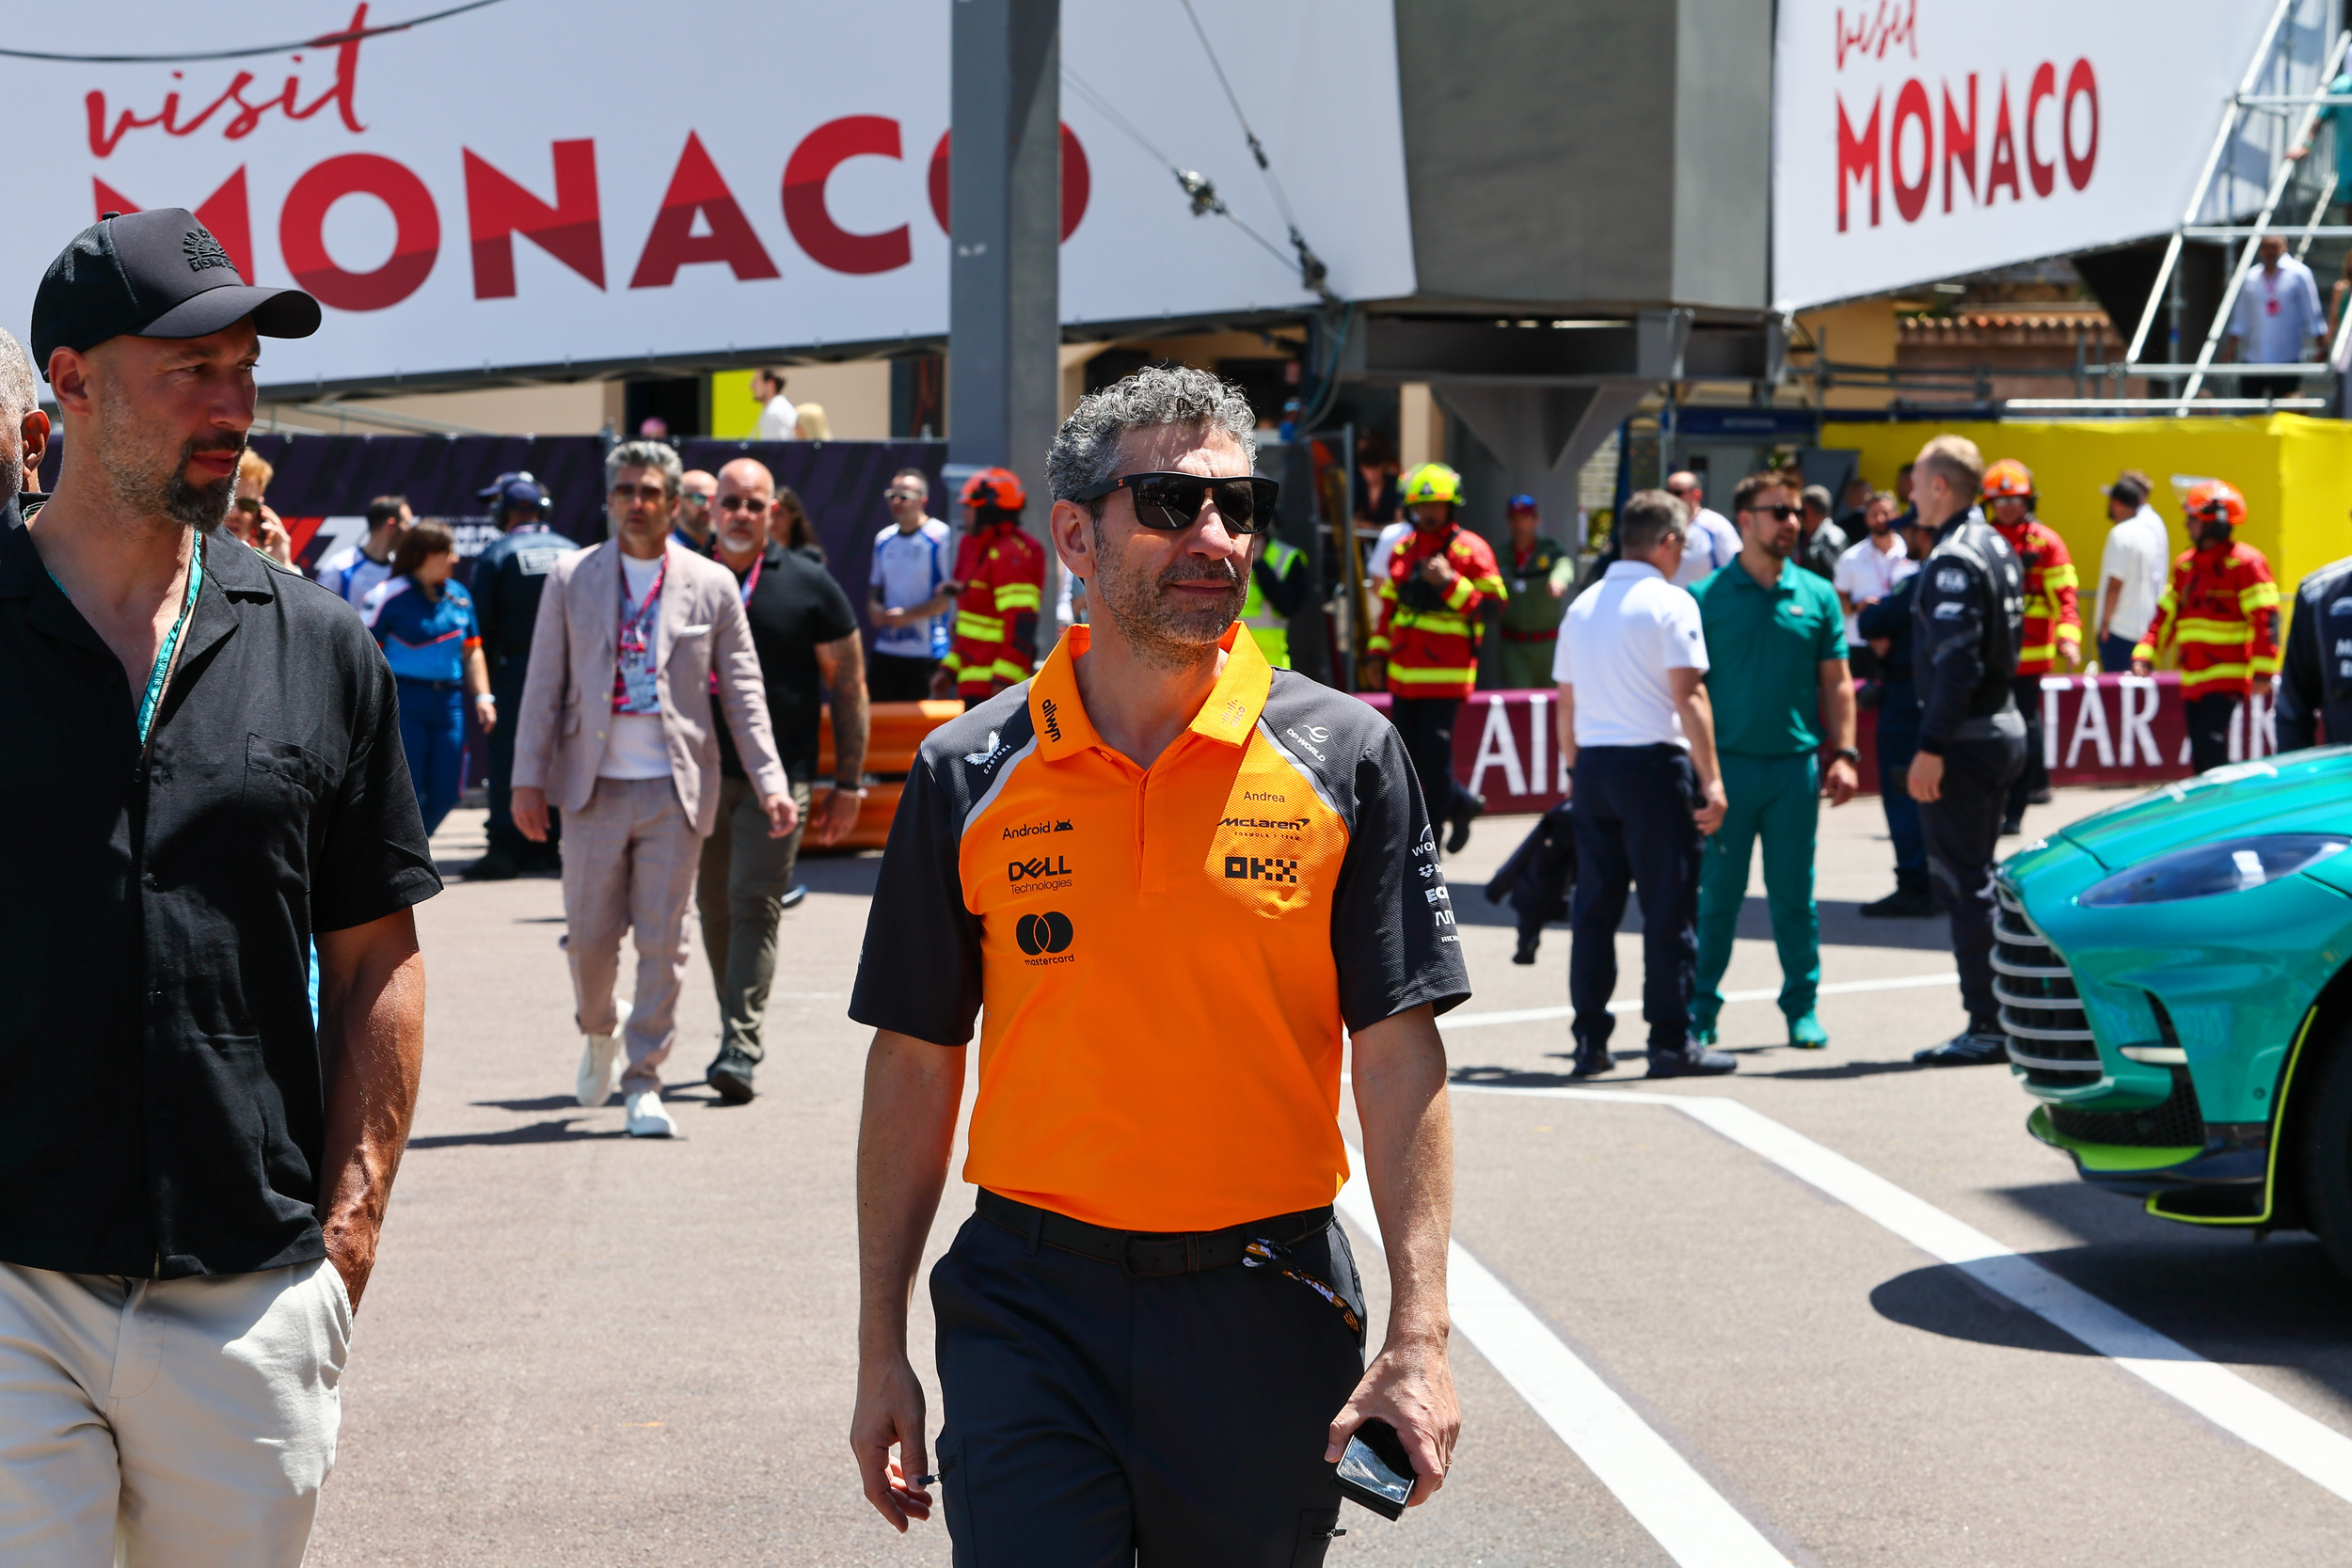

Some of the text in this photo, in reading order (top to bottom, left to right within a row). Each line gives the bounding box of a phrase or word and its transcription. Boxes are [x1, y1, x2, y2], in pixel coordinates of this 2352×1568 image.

[85, 2, 410, 158] visit
[1836, 55, 2100, 233] MONACO
[91, 114, 1091, 313] MONAC
[1041, 699, 1062, 743] allwyn
[2040, 674, 2163, 769] TAR
[983, 743, 1012, 775] CASTORE
[1286, 728, 1327, 762] DP WORLD
[1243, 791, 1286, 803] Andrea
[1002, 821, 1051, 840] Android
[1216, 818, 1301, 832] McLaren
[1009, 855, 1073, 882] DELL
[1225, 856, 1297, 883] OKX
[1010, 879, 1073, 895] Technologies
[1025, 953, 1075, 966] mastercard
